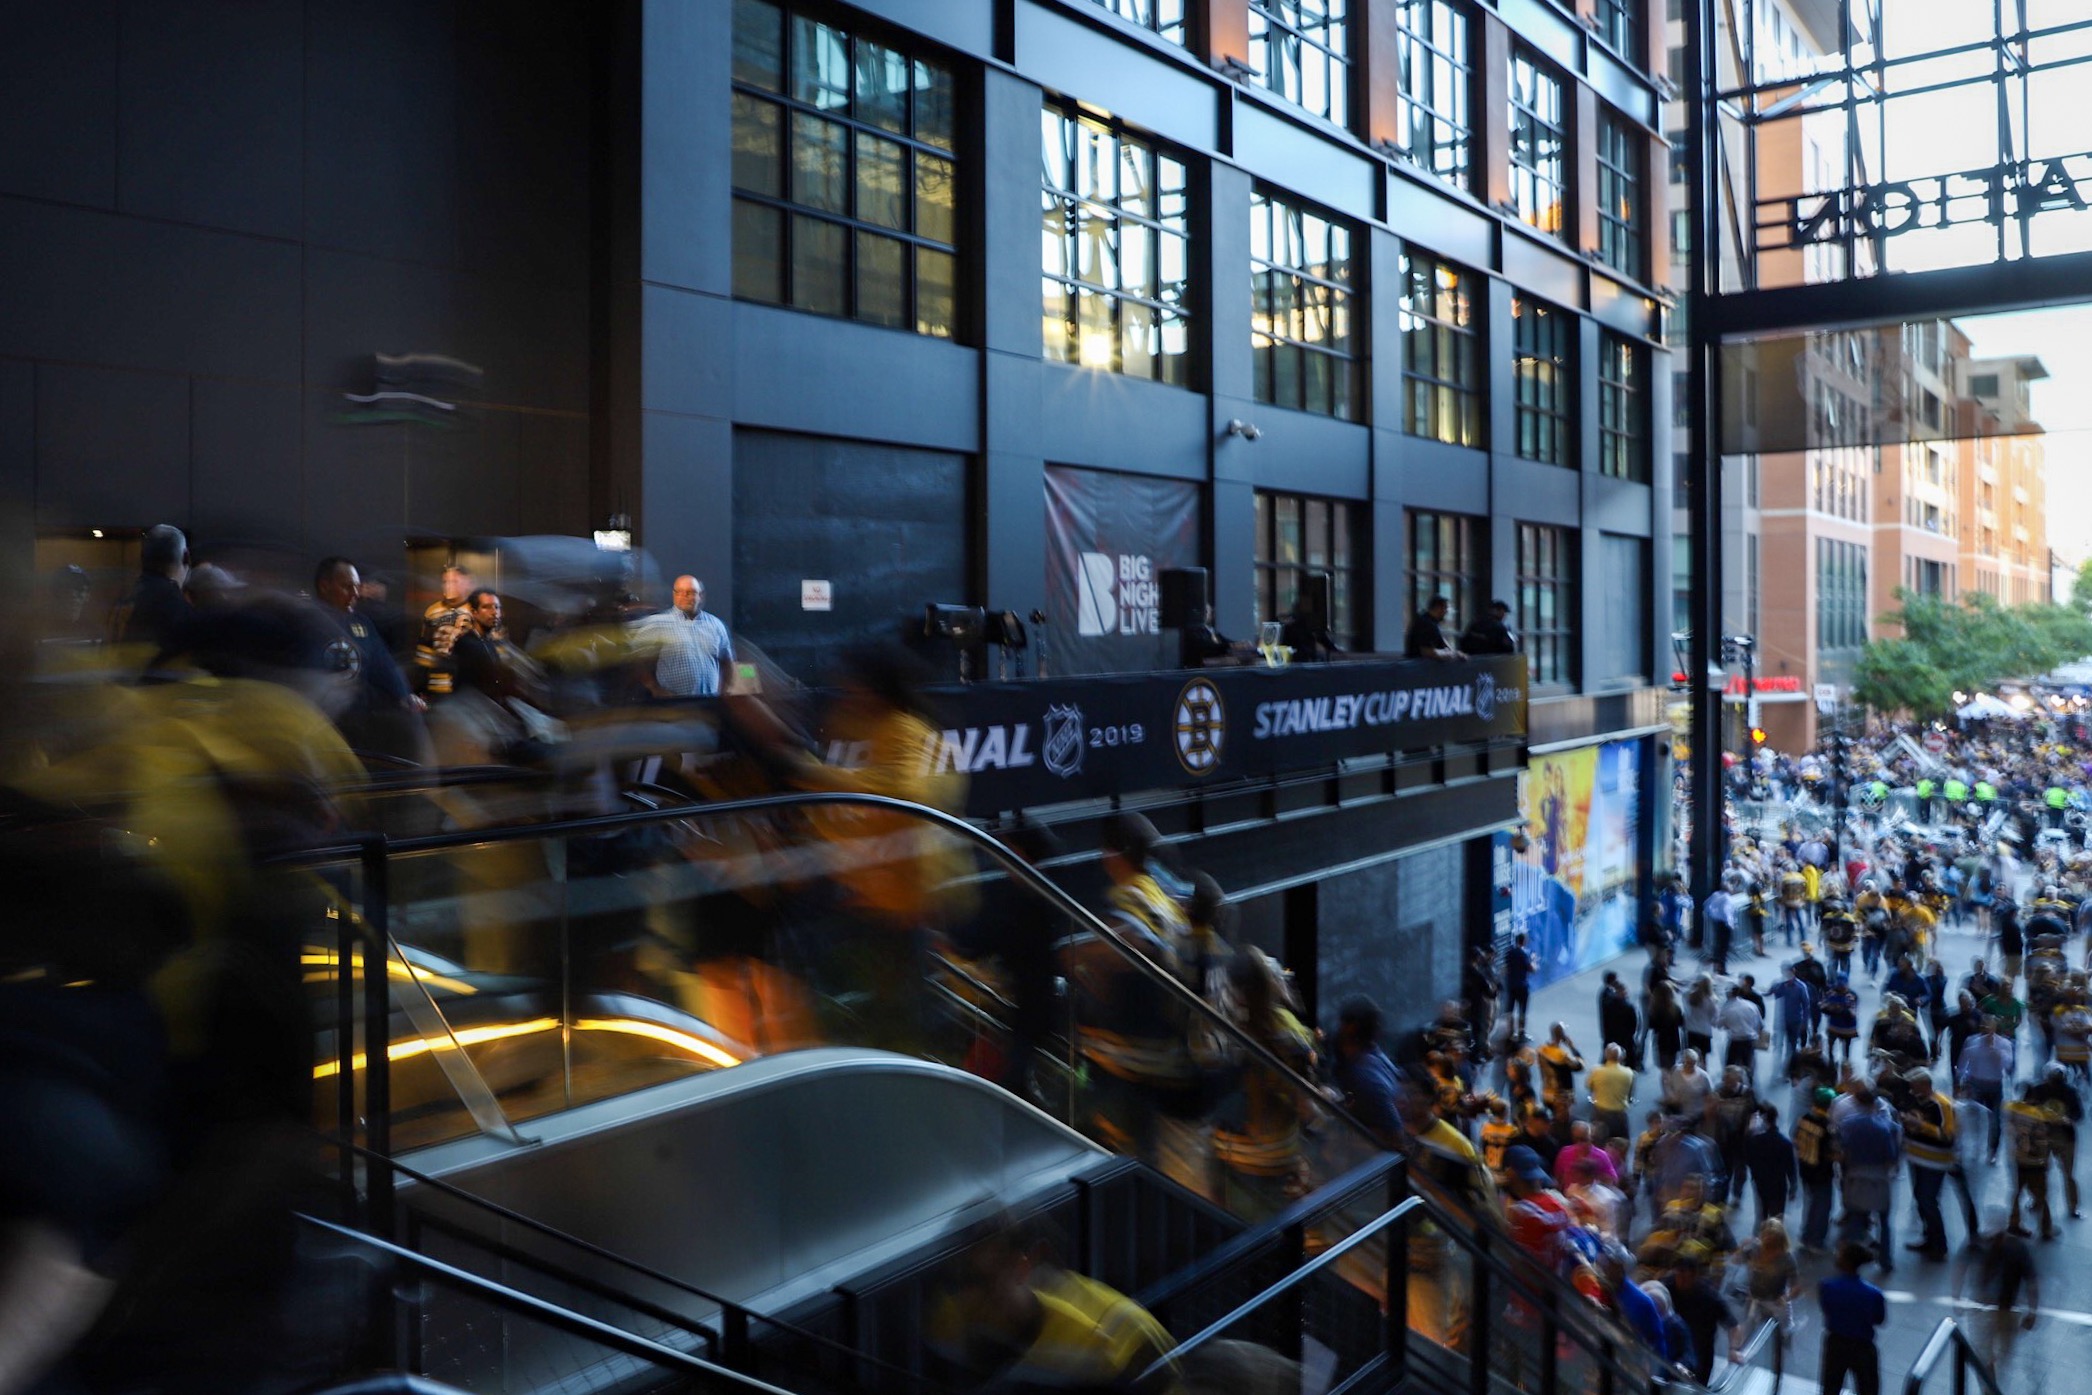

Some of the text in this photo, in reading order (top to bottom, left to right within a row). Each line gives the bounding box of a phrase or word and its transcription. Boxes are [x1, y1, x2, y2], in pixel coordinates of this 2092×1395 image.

[1119, 554, 1151, 582] BIG
[1119, 582, 1160, 608] NIGH
[1119, 608, 1160, 635] LIVE
[1253, 694, 1364, 739] STANLEY
[1363, 689, 1410, 725] CUP
[1409, 684, 1474, 720] FINAL
[917, 722, 1036, 778] INAL
[1089, 723, 1146, 748] 2019
